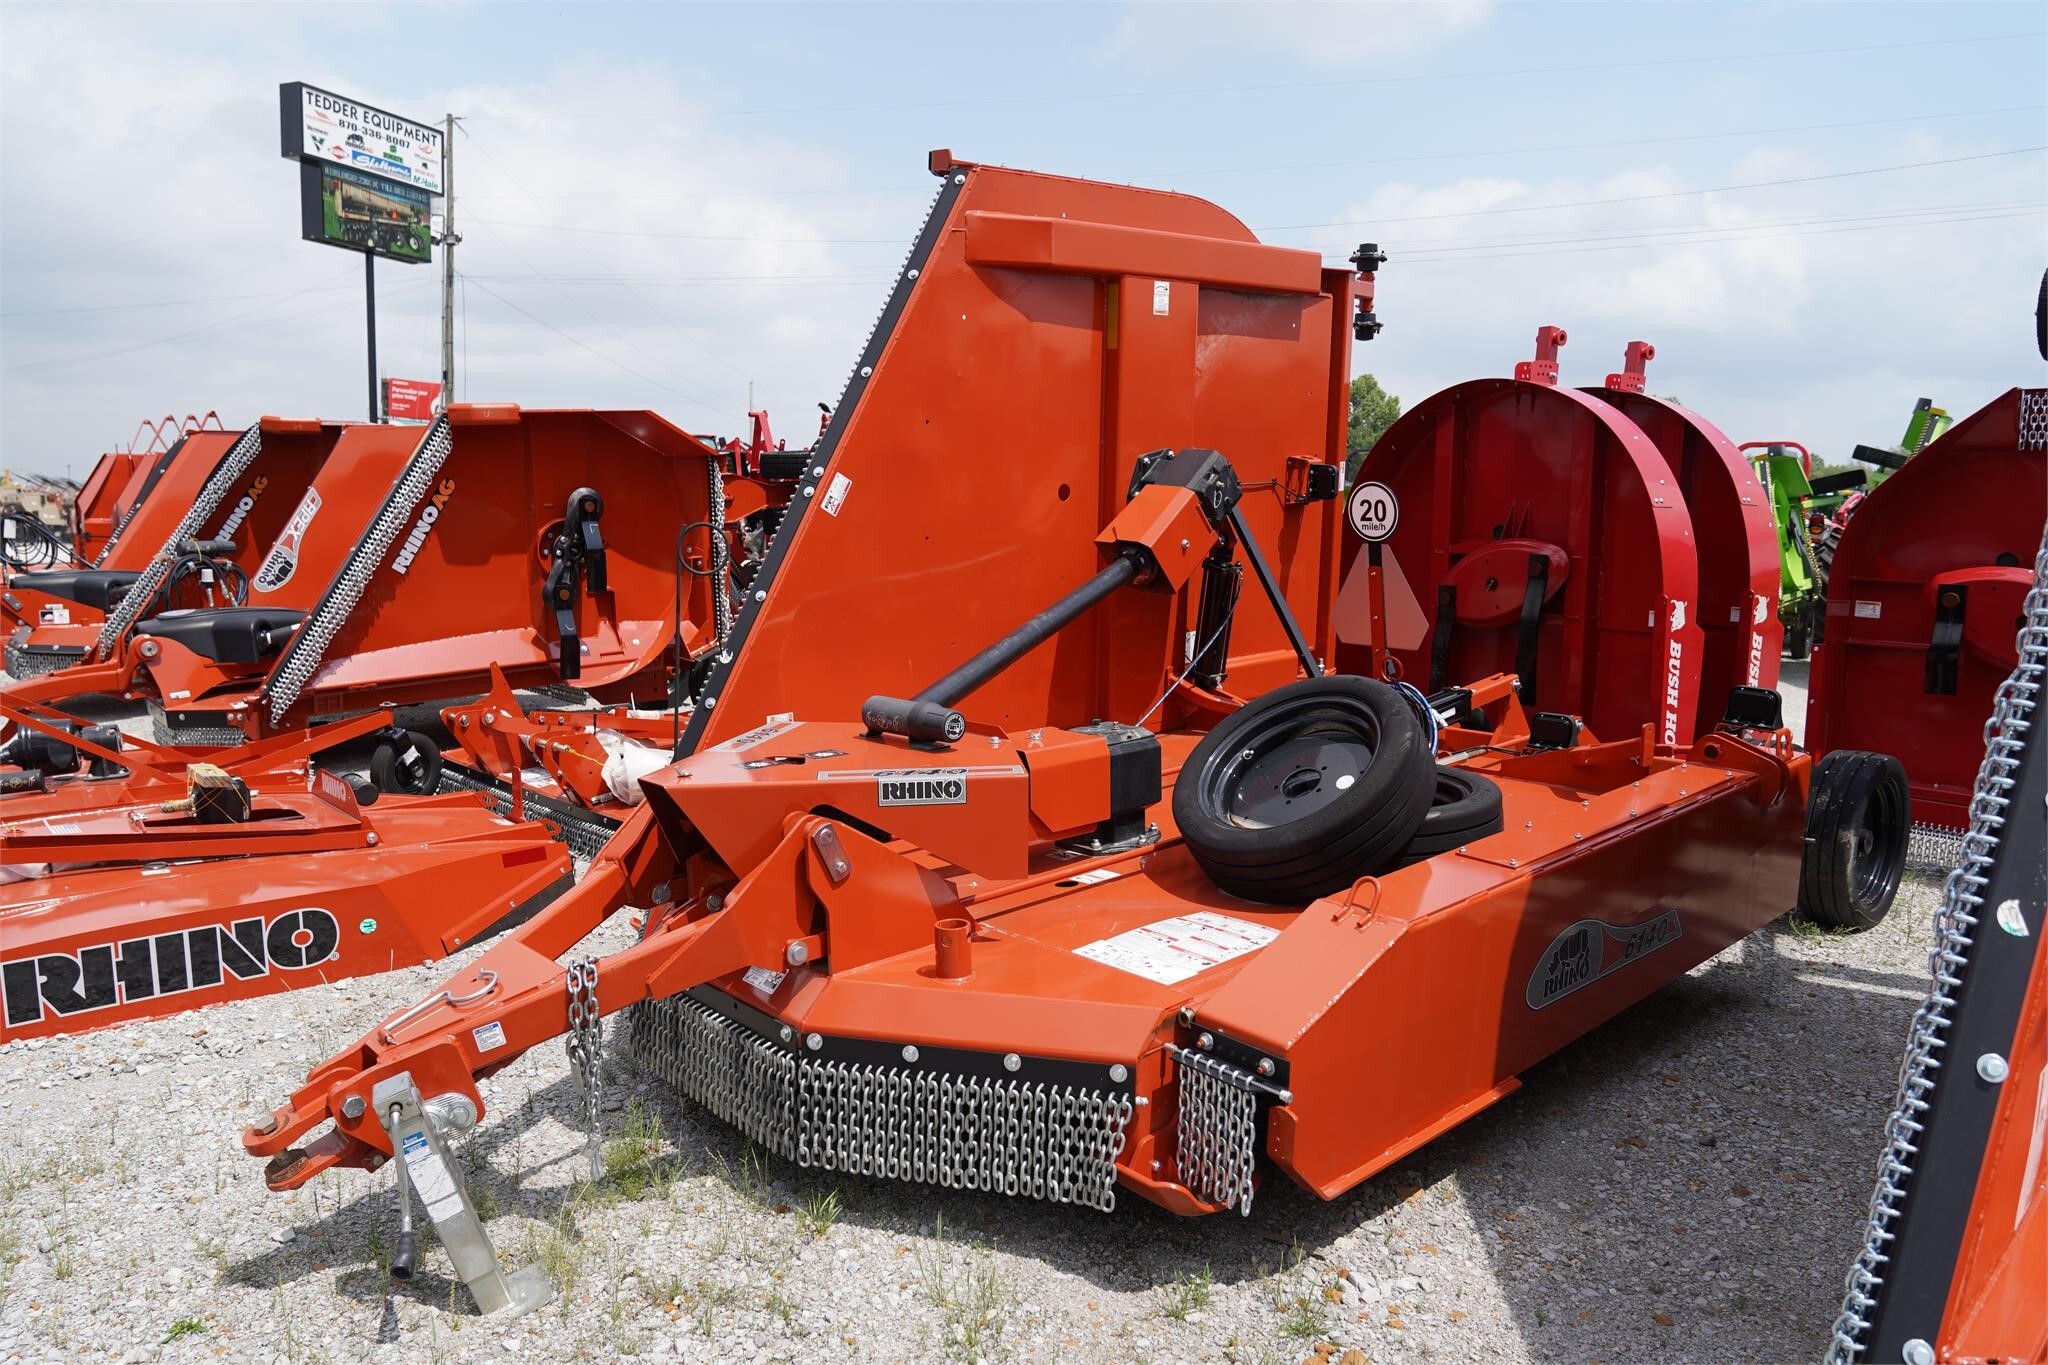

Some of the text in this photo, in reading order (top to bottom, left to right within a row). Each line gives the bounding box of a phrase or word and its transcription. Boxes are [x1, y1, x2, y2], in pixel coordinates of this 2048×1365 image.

[306, 91, 437, 147] TEDDER EQUIPMENT
[338, 119, 410, 149] 870-336-8007
[1360, 499, 1387, 522] 20
[1361, 522, 1386, 531] mile/h
[1664, 639, 1682, 745] BUSH HO
[881, 779, 962, 801] RHINO
[1624, 918, 1668, 960] 6140
[1543, 952, 1591, 998] RHINO
